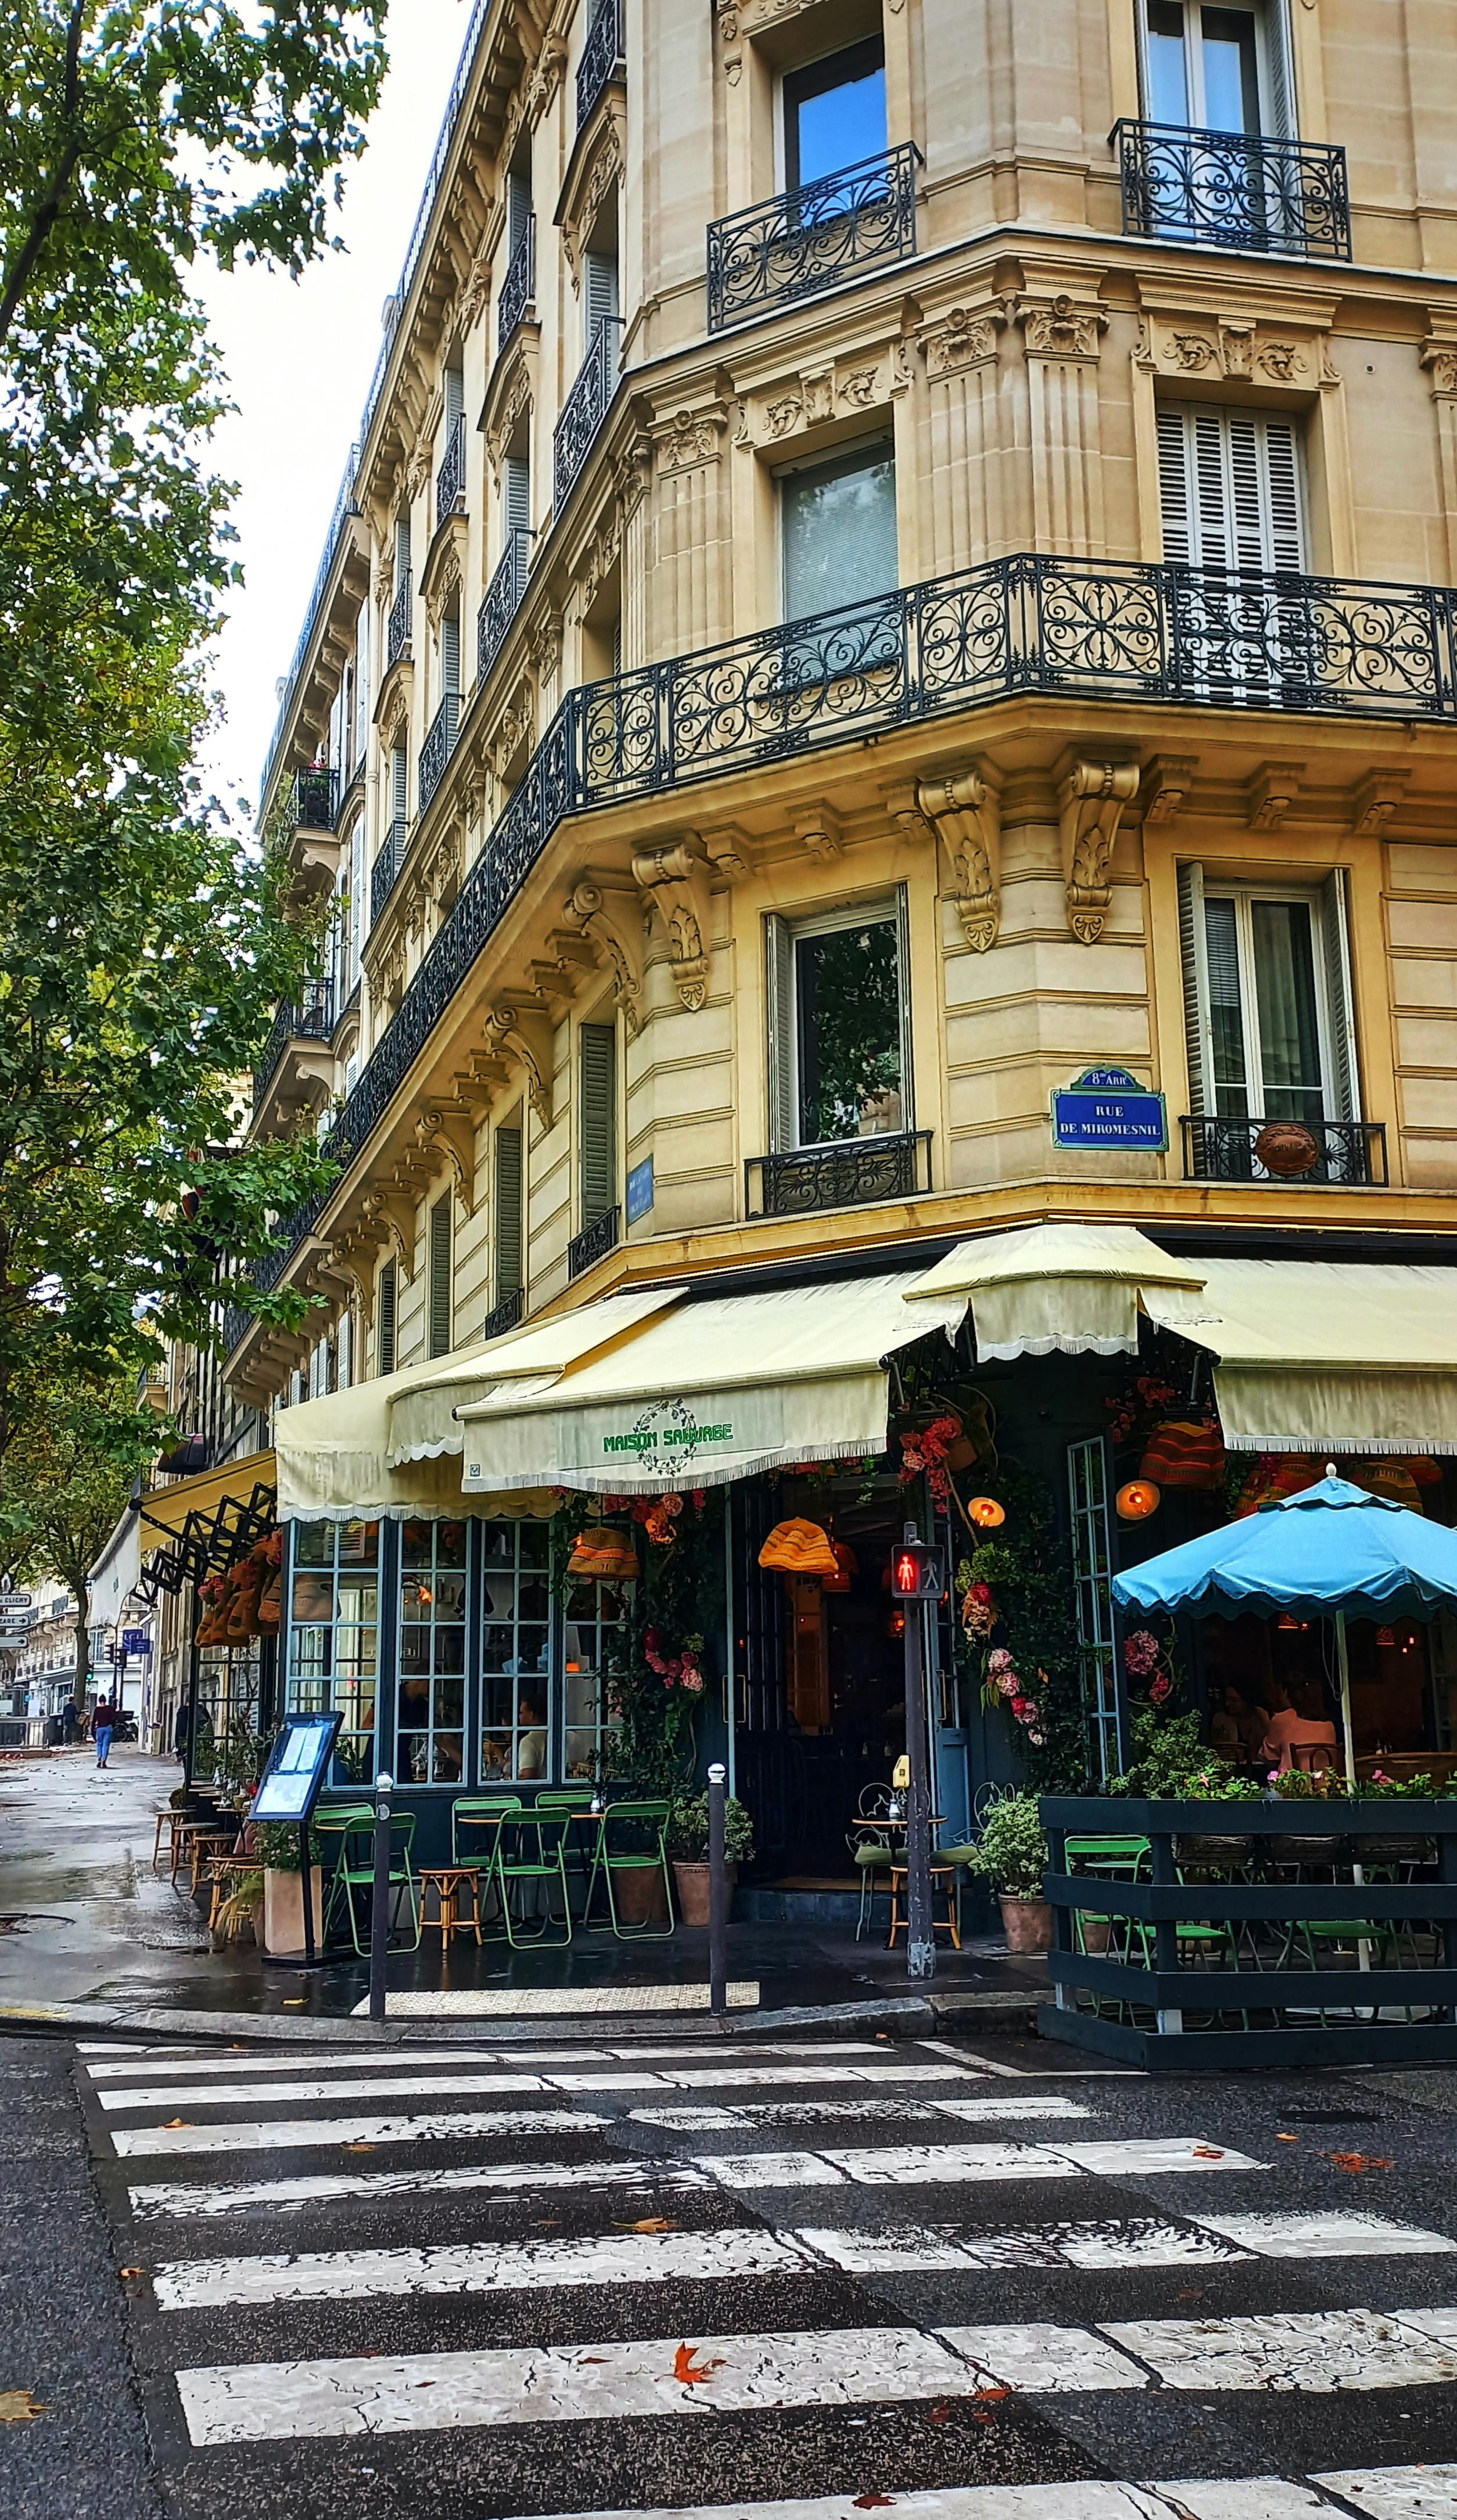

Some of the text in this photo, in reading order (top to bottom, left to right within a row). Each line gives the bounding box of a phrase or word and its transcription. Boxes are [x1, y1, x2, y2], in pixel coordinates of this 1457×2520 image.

[1096, 1106, 1124, 1117] RUE
[1060, 1123, 1161, 1136] DE MIROMESNIL
[603, 1431, 658, 1453] MAISON
